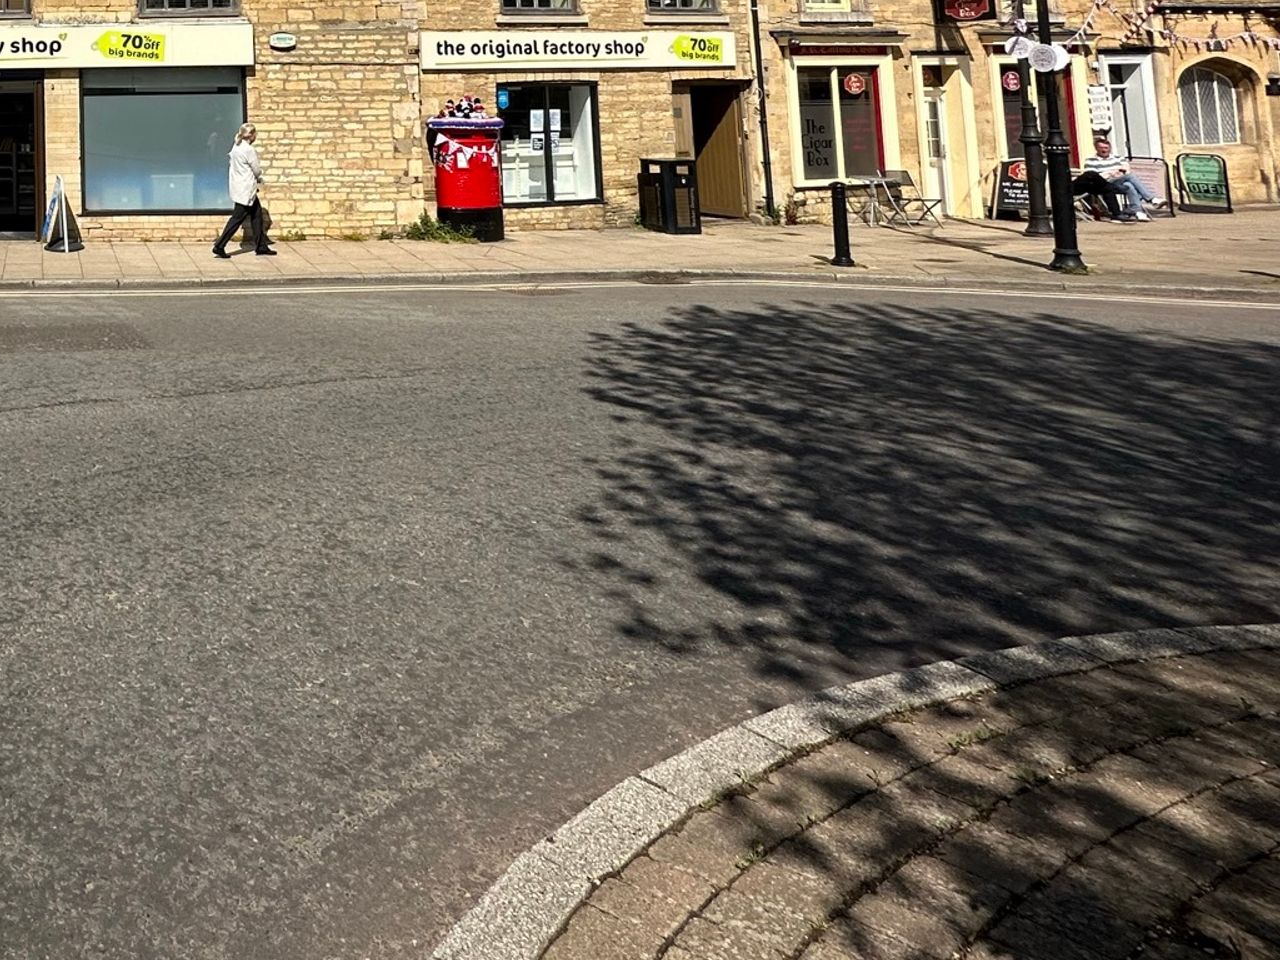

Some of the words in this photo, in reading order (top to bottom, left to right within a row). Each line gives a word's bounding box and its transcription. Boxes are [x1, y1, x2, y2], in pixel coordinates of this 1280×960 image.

[959, 9, 976, 18] Box
[10, 37, 63, 55] shop
[144, 41, 161, 50] off
[436, 40, 465, 56] the
[470, 40, 539, 58] original
[543, 39, 601, 58] factory
[605, 40, 645, 56] shop
[707, 44, 719, 53] off
[108, 48, 125, 58] big
[126, 49, 160, 59] brands
[681, 50, 694, 60] big
[695, 52, 720, 61] brands
[805, 119, 825, 134] The
[802, 134, 833, 155] Cigar
[806, 151, 830, 167] Box
[1189, 183, 1226, 194] OPEN
